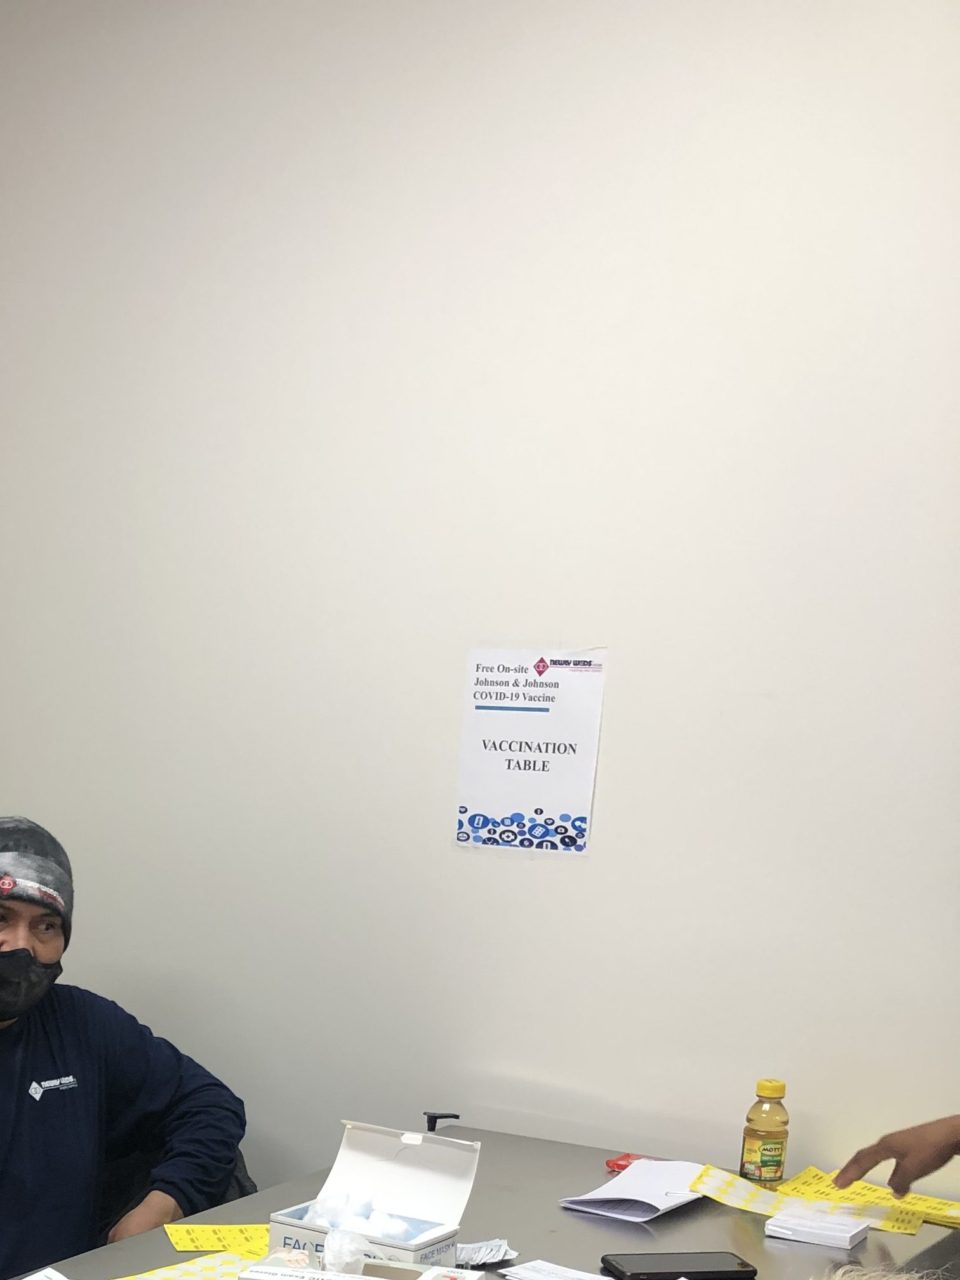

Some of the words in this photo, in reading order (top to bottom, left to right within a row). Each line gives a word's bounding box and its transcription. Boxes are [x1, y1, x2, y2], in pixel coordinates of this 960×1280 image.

[476, 664, 494, 673] Free
[497, 664, 529, 674] On-site
[474, 677, 510, 687] Johnson
[512, 678, 520, 687] &
[523, 679, 560, 689] Johnson
[473, 691, 520, 702] COVID-19
[522, 692, 556, 703] Vaccine
[482, 739, 578, 755] VACCINATION
[505, 758, 550, 772] TABLE
